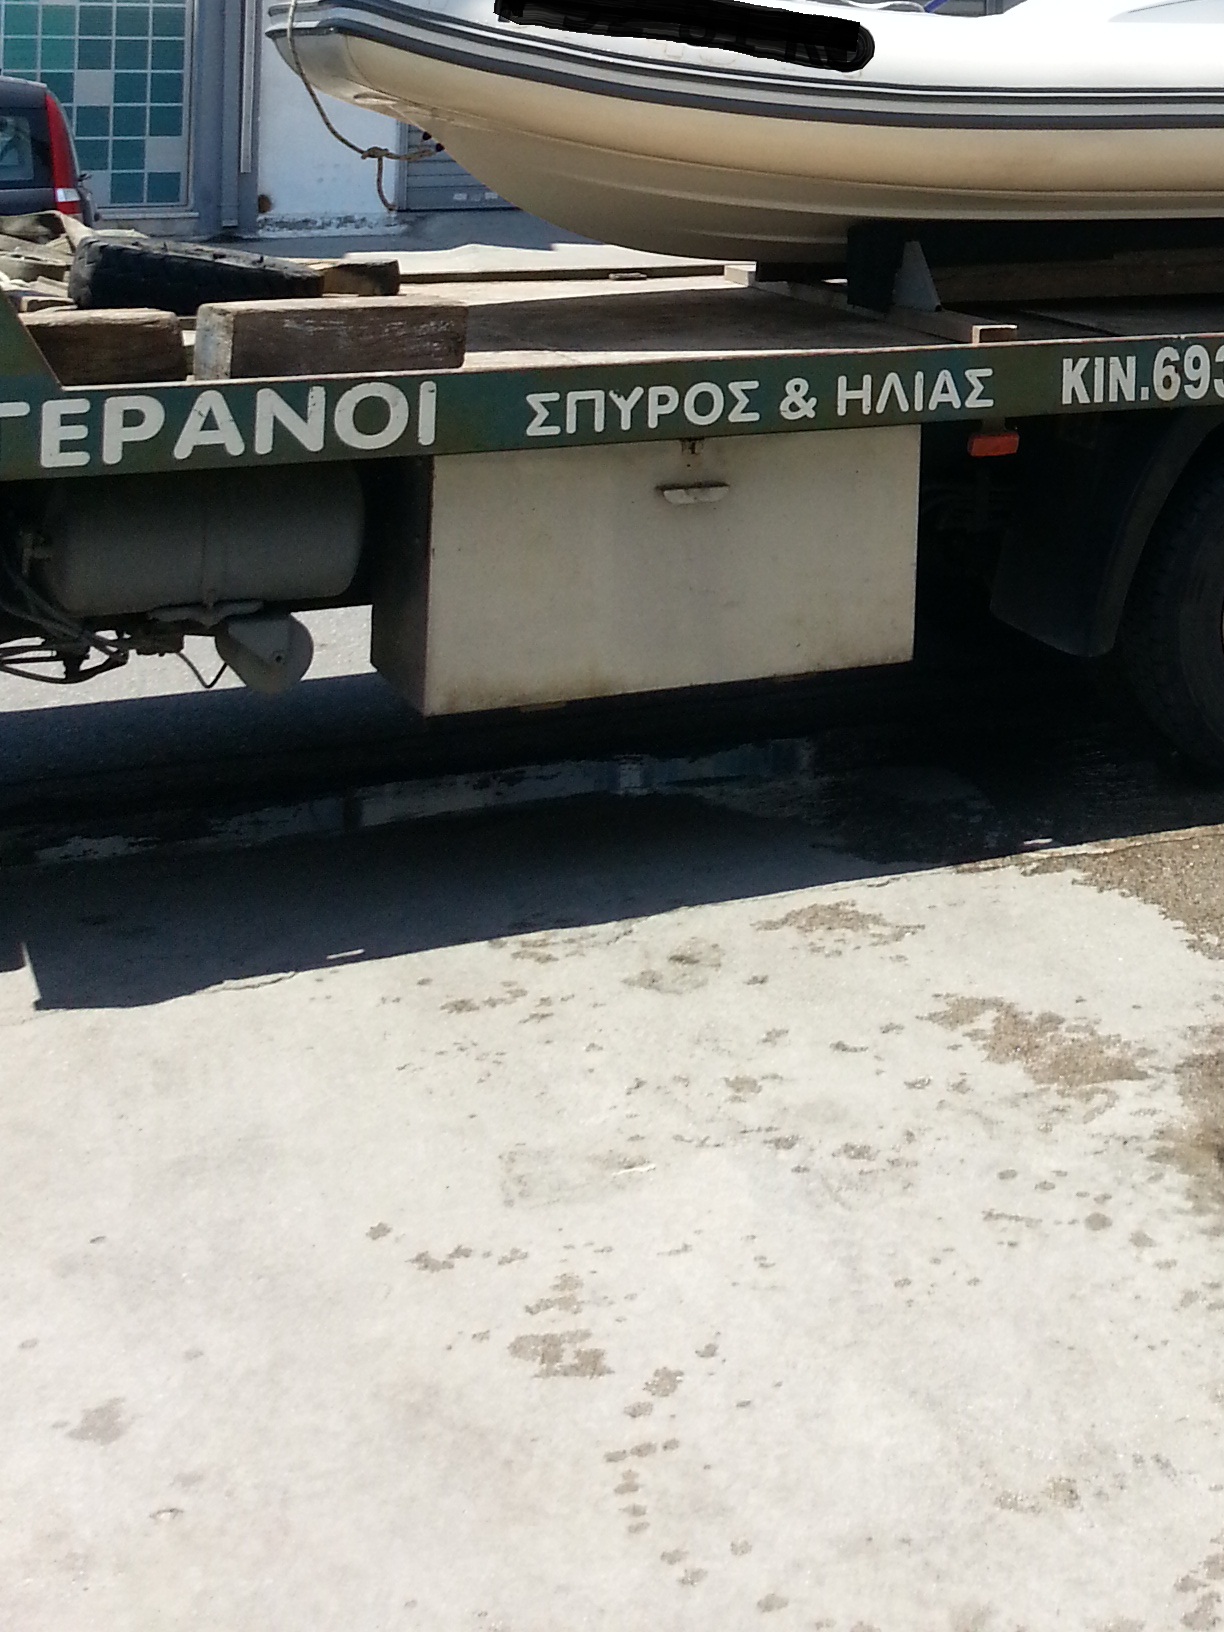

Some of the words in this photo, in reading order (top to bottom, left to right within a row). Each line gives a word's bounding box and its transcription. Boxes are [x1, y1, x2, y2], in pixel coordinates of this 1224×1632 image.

[526, 380, 760, 436] ΣΠΥΡΟΣ
[780, 377, 817, 419] &
[837, 368, 994, 415] ΗΛΙΑΣ
